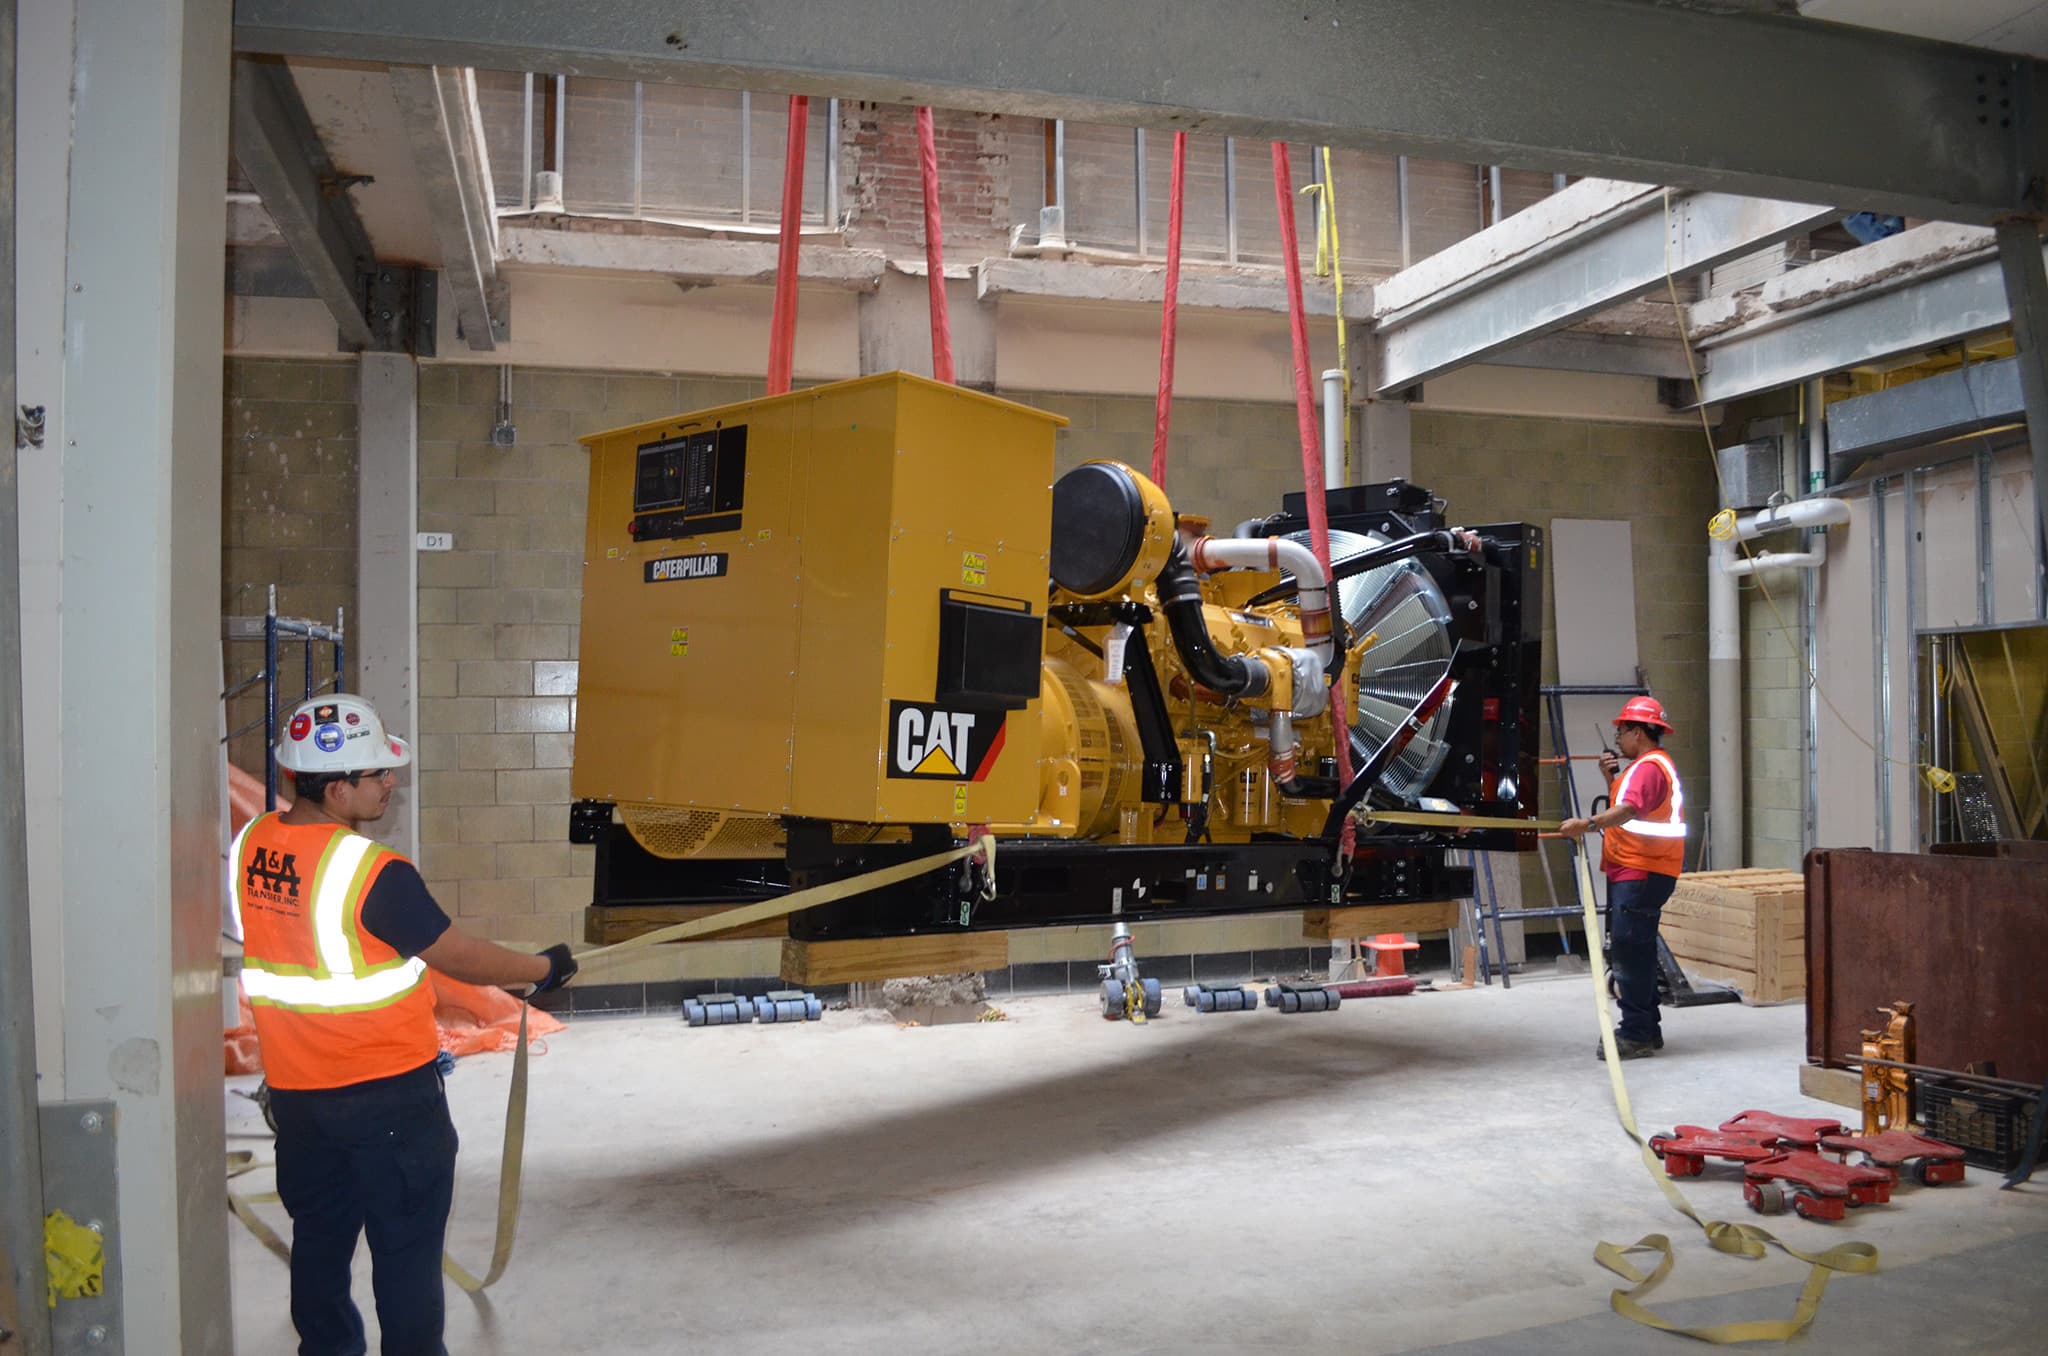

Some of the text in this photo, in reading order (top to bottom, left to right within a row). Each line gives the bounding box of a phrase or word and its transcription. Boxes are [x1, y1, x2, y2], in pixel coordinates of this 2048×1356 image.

[427, 535, 443, 547] D1
[653, 555, 718, 580] CATERPILLAR
[897, 707, 976, 775] CAT
[247, 846, 301, 897] A&A
